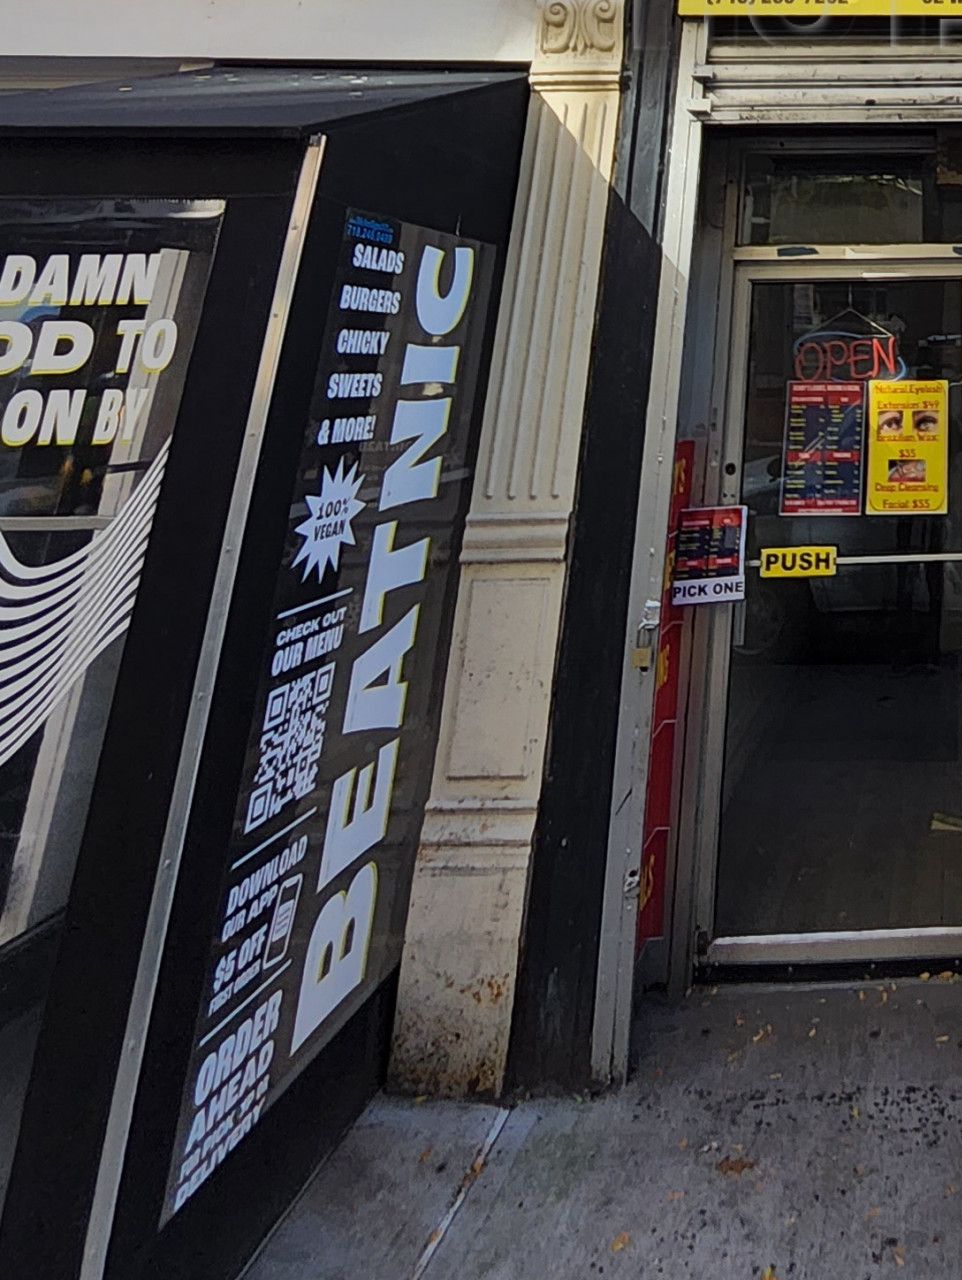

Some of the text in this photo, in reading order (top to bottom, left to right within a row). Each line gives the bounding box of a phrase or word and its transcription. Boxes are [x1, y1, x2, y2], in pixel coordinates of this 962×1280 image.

[0, 254, 161, 306] DAMN
[352, 242, 405, 275] SALADS
[339, 284, 402, 314] BURGERS
[116, 318, 178, 374] TO
[336, 328, 391, 355] CHICKY
[798, 337, 896, 381] OPEN
[327, 372, 383, 399] SWEETS
[1, 388, 150, 447] ON BY
[317, 422, 330, 447] &
[331, 415, 377, 445] MORE!
[314, 520, 345, 542] VEGAN
[316, 498, 350, 521] 100%
[764, 551, 831, 571] PUSH
[672, 581, 744, 599] PICK ONE
[276, 606, 347, 647] CHECK OUT
[271, 623, 345, 677] OUR MENU
[226, 834, 308, 917] DOWNLOAD
[221, 884, 279, 943] OUR APP
[213, 923, 268, 994] $5 OFF
[194, 989, 283, 1107] ORDER
[184, 1039, 275, 1156] AHEAD
[174, 1096, 267, 1214] DELIVERY
